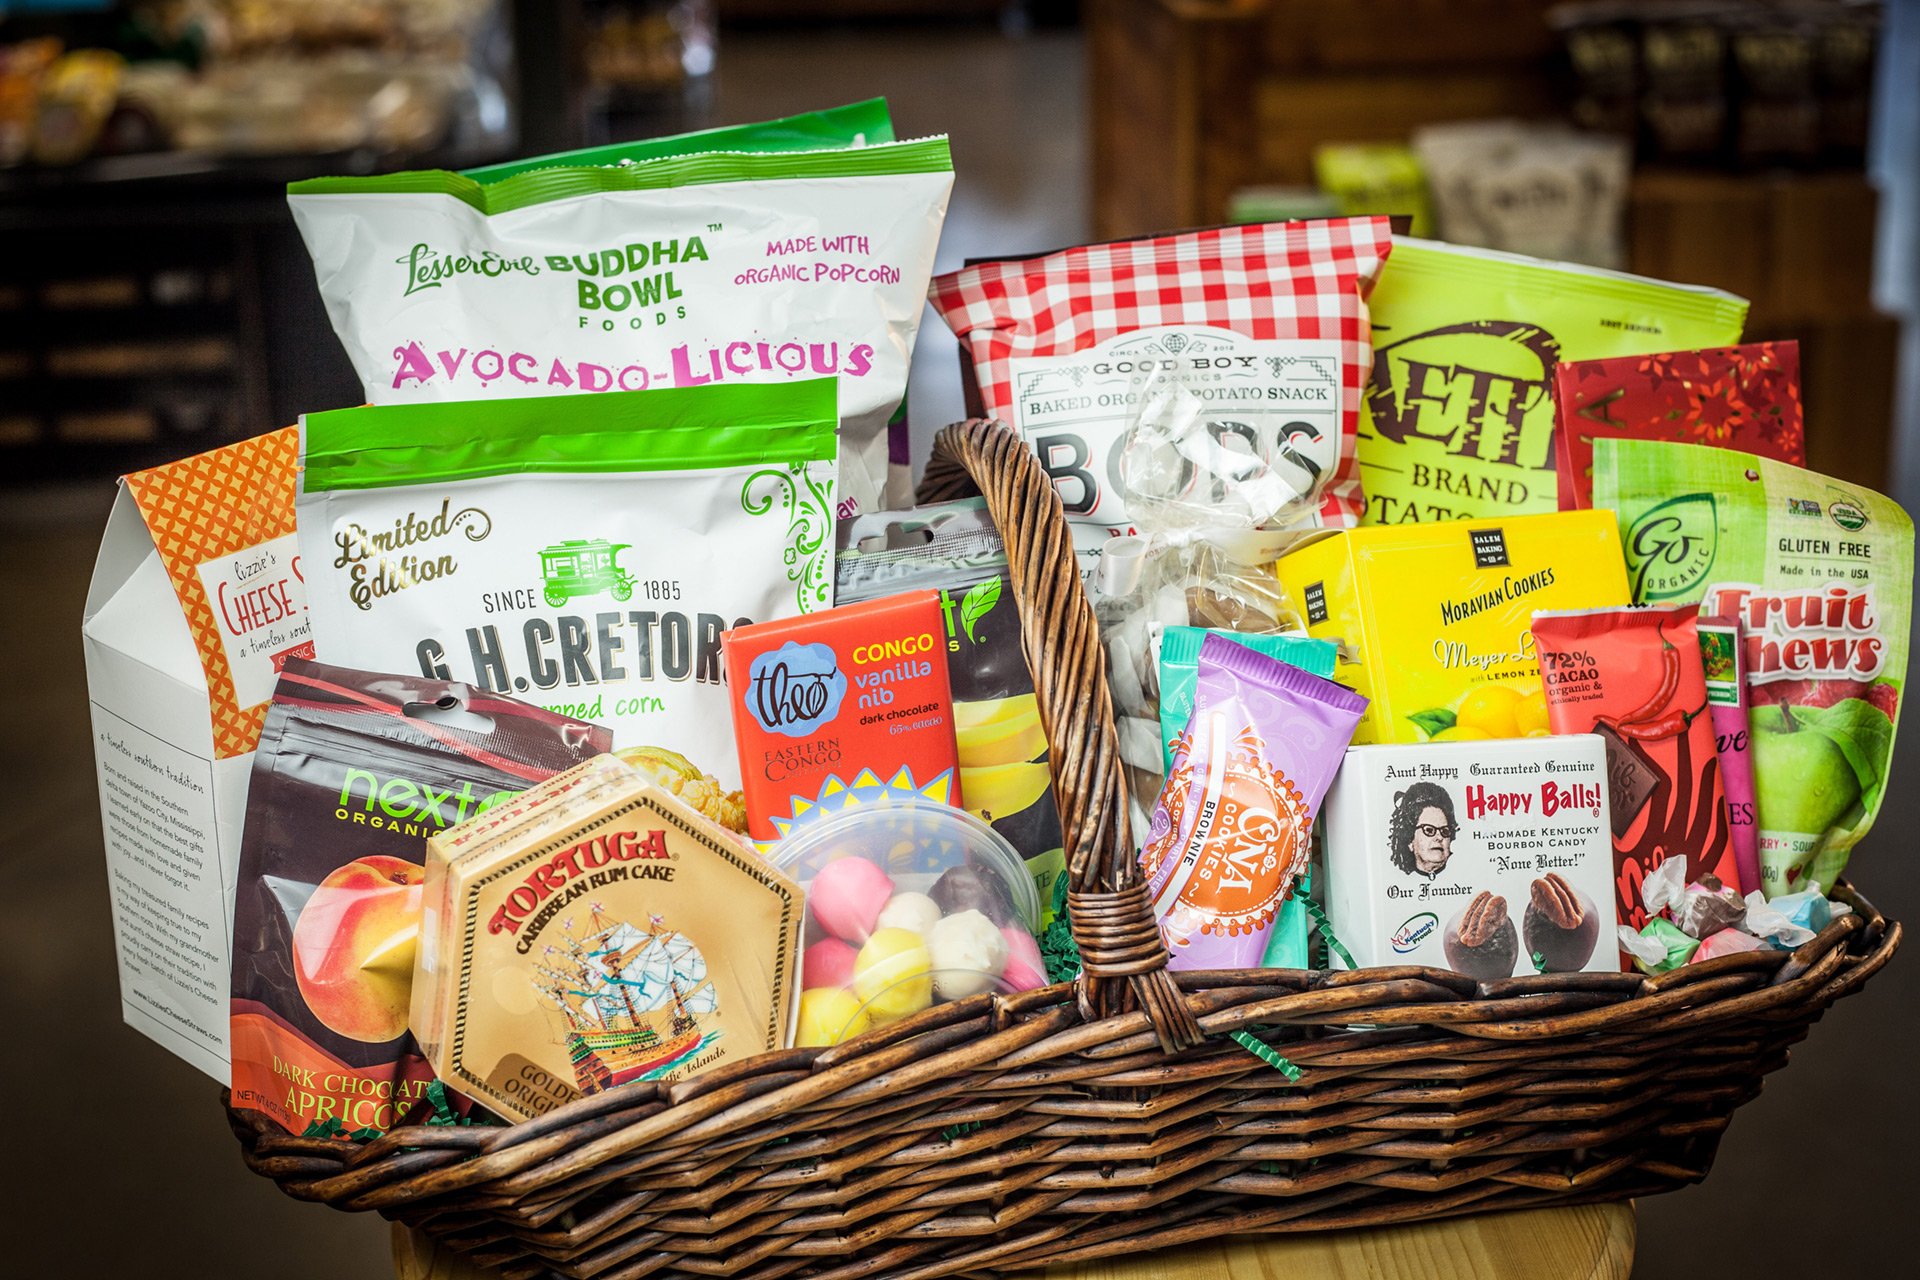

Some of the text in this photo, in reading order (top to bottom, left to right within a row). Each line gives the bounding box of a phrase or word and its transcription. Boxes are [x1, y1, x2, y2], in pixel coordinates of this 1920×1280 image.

[544, 236, 710, 277] BUDDHA
[766, 235, 870, 257] MADE WITH
[734, 262, 901, 286] ORGANIC POPCORN
[577, 270, 682, 312] BOWL
[578, 305, 687, 332] FOODS
[1093, 356, 1257, 374] GOOD BOY
[1109, 350, 1140, 358] CIRCA
[1133, 373, 1222, 385] OGANICS
[1029, 397, 1094, 415] BAKED
[1193, 386, 1263, 401] POTATO
[1267, 386, 1328, 401] SNACK
[1412, 462, 1528, 505] BRAND
[334, 497, 470, 569] Limited
[1474, 535, 1501, 544] SALEM
[1477, 545, 1503, 554] BAKING
[1779, 538, 1871, 558] GLUTEN FREE
[349, 549, 457, 610] Edition
[1647, 548, 1710, 589] ORGANIC
[1780, 564, 1869, 579] Made in the USA
[482, 586, 537, 614] SINCE
[643, 580, 681, 601] 1885
[1306, 589, 1323, 600] SALEM
[1440, 567, 1556, 627] MORAVIAN COOKIES
[217, 579, 297, 636] CHEESE
[1308, 599, 1324, 611] BAKING
[1716, 588, 1874, 630] Fruit
[240, 648, 248, 658] a
[250, 629, 285, 654] timeless
[852, 633, 934, 665] CONGO
[1433, 638, 1509, 671] Meyer
[1744, 635, 1882, 673] hews
[1543, 650, 1596, 670] 72%
[854, 659, 932, 689] vanilla
[1487, 670, 1526, 681] LEMON
[1546, 669, 1599, 685] CACAO
[753, 661, 836, 728] theo
[858, 686, 895, 710] nib
[1549, 681, 1603, 696] organic &
[1550, 692, 1604, 706] ethically traded
[615, 696, 665, 716] corn
[859, 702, 940, 726] dark chocolate
[764, 737, 840, 762] EASTERN
[764, 748, 841, 782] CONGO
[1384, 763, 1459, 783] Aunt Happy
[1469, 760, 1595, 777] Guaranteed Genuine
[165, 765, 203, 794] tradition
[160, 795, 188, 816] Southern
[339, 767, 475, 827] next
[1466, 784, 1532, 821] Happy
[1541, 781, 1601, 817] Balls!
[335, 808, 443, 838] ORGANI
[1183, 800, 1216, 867] BROWNIE
[1541, 826, 1599, 837] KENTUCKY
[173, 832, 188, 846] best
[188, 838, 203, 855] gifts
[1199, 802, 1237, 881] COOKIES
[1488, 838, 1587, 851] BOURBON CANDY
[182, 867, 200, 883] given
[488, 829, 671, 937] TORTUGA
[1386, 883, 1473, 901] Our Founder
[516, 864, 676, 955] CARIBBEAN RUM CAKE
[1404, 919, 1435, 945] Kentucky
[273, 1055, 318, 1090] DARK
[684, 1047, 727, 1075] Islands
[237, 1089, 255, 1101] NET
[520, 1064, 586, 1101] GOLDE
[285, 1086, 412, 1129] APRICOS
